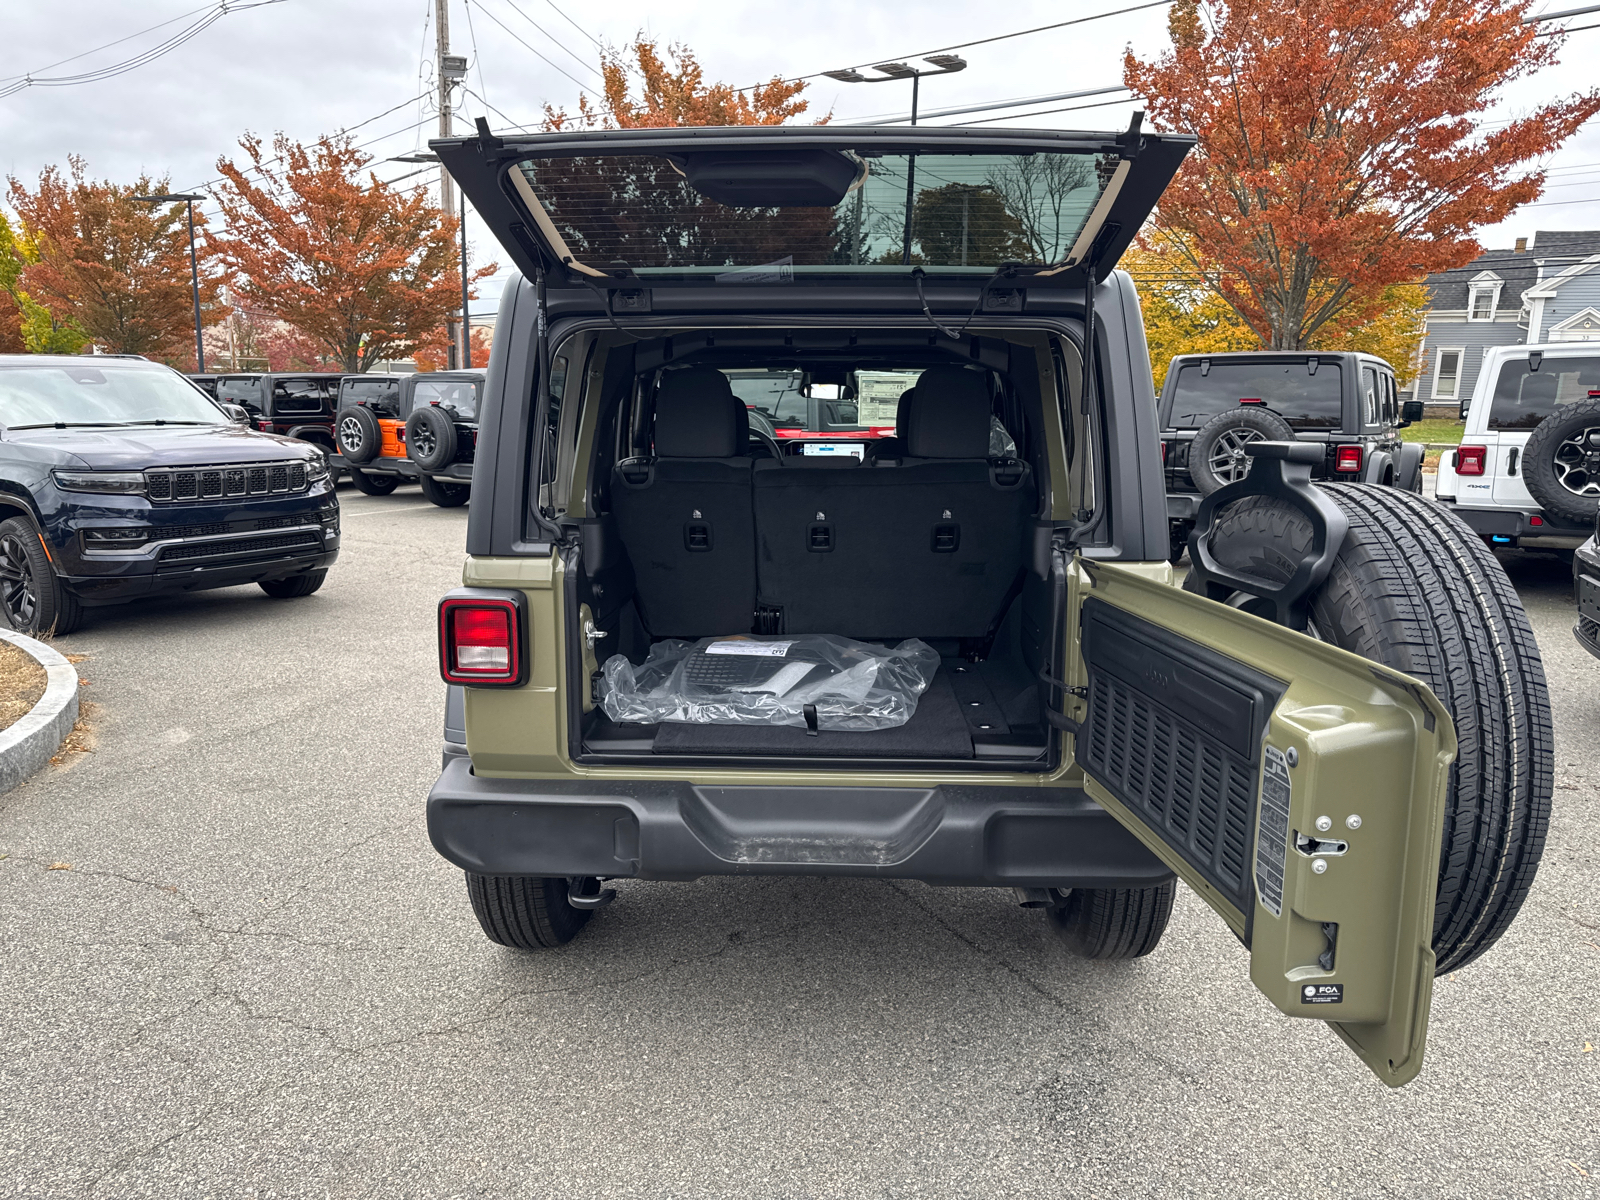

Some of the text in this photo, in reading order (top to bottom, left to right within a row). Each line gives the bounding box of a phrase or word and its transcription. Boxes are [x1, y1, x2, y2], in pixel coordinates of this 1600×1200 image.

[1145, 662, 1168, 689] Jeep
[1270, 749, 1280, 759] Jeep
[1265, 762, 1288, 779] JL
[1268, 873, 1281, 888] USA
